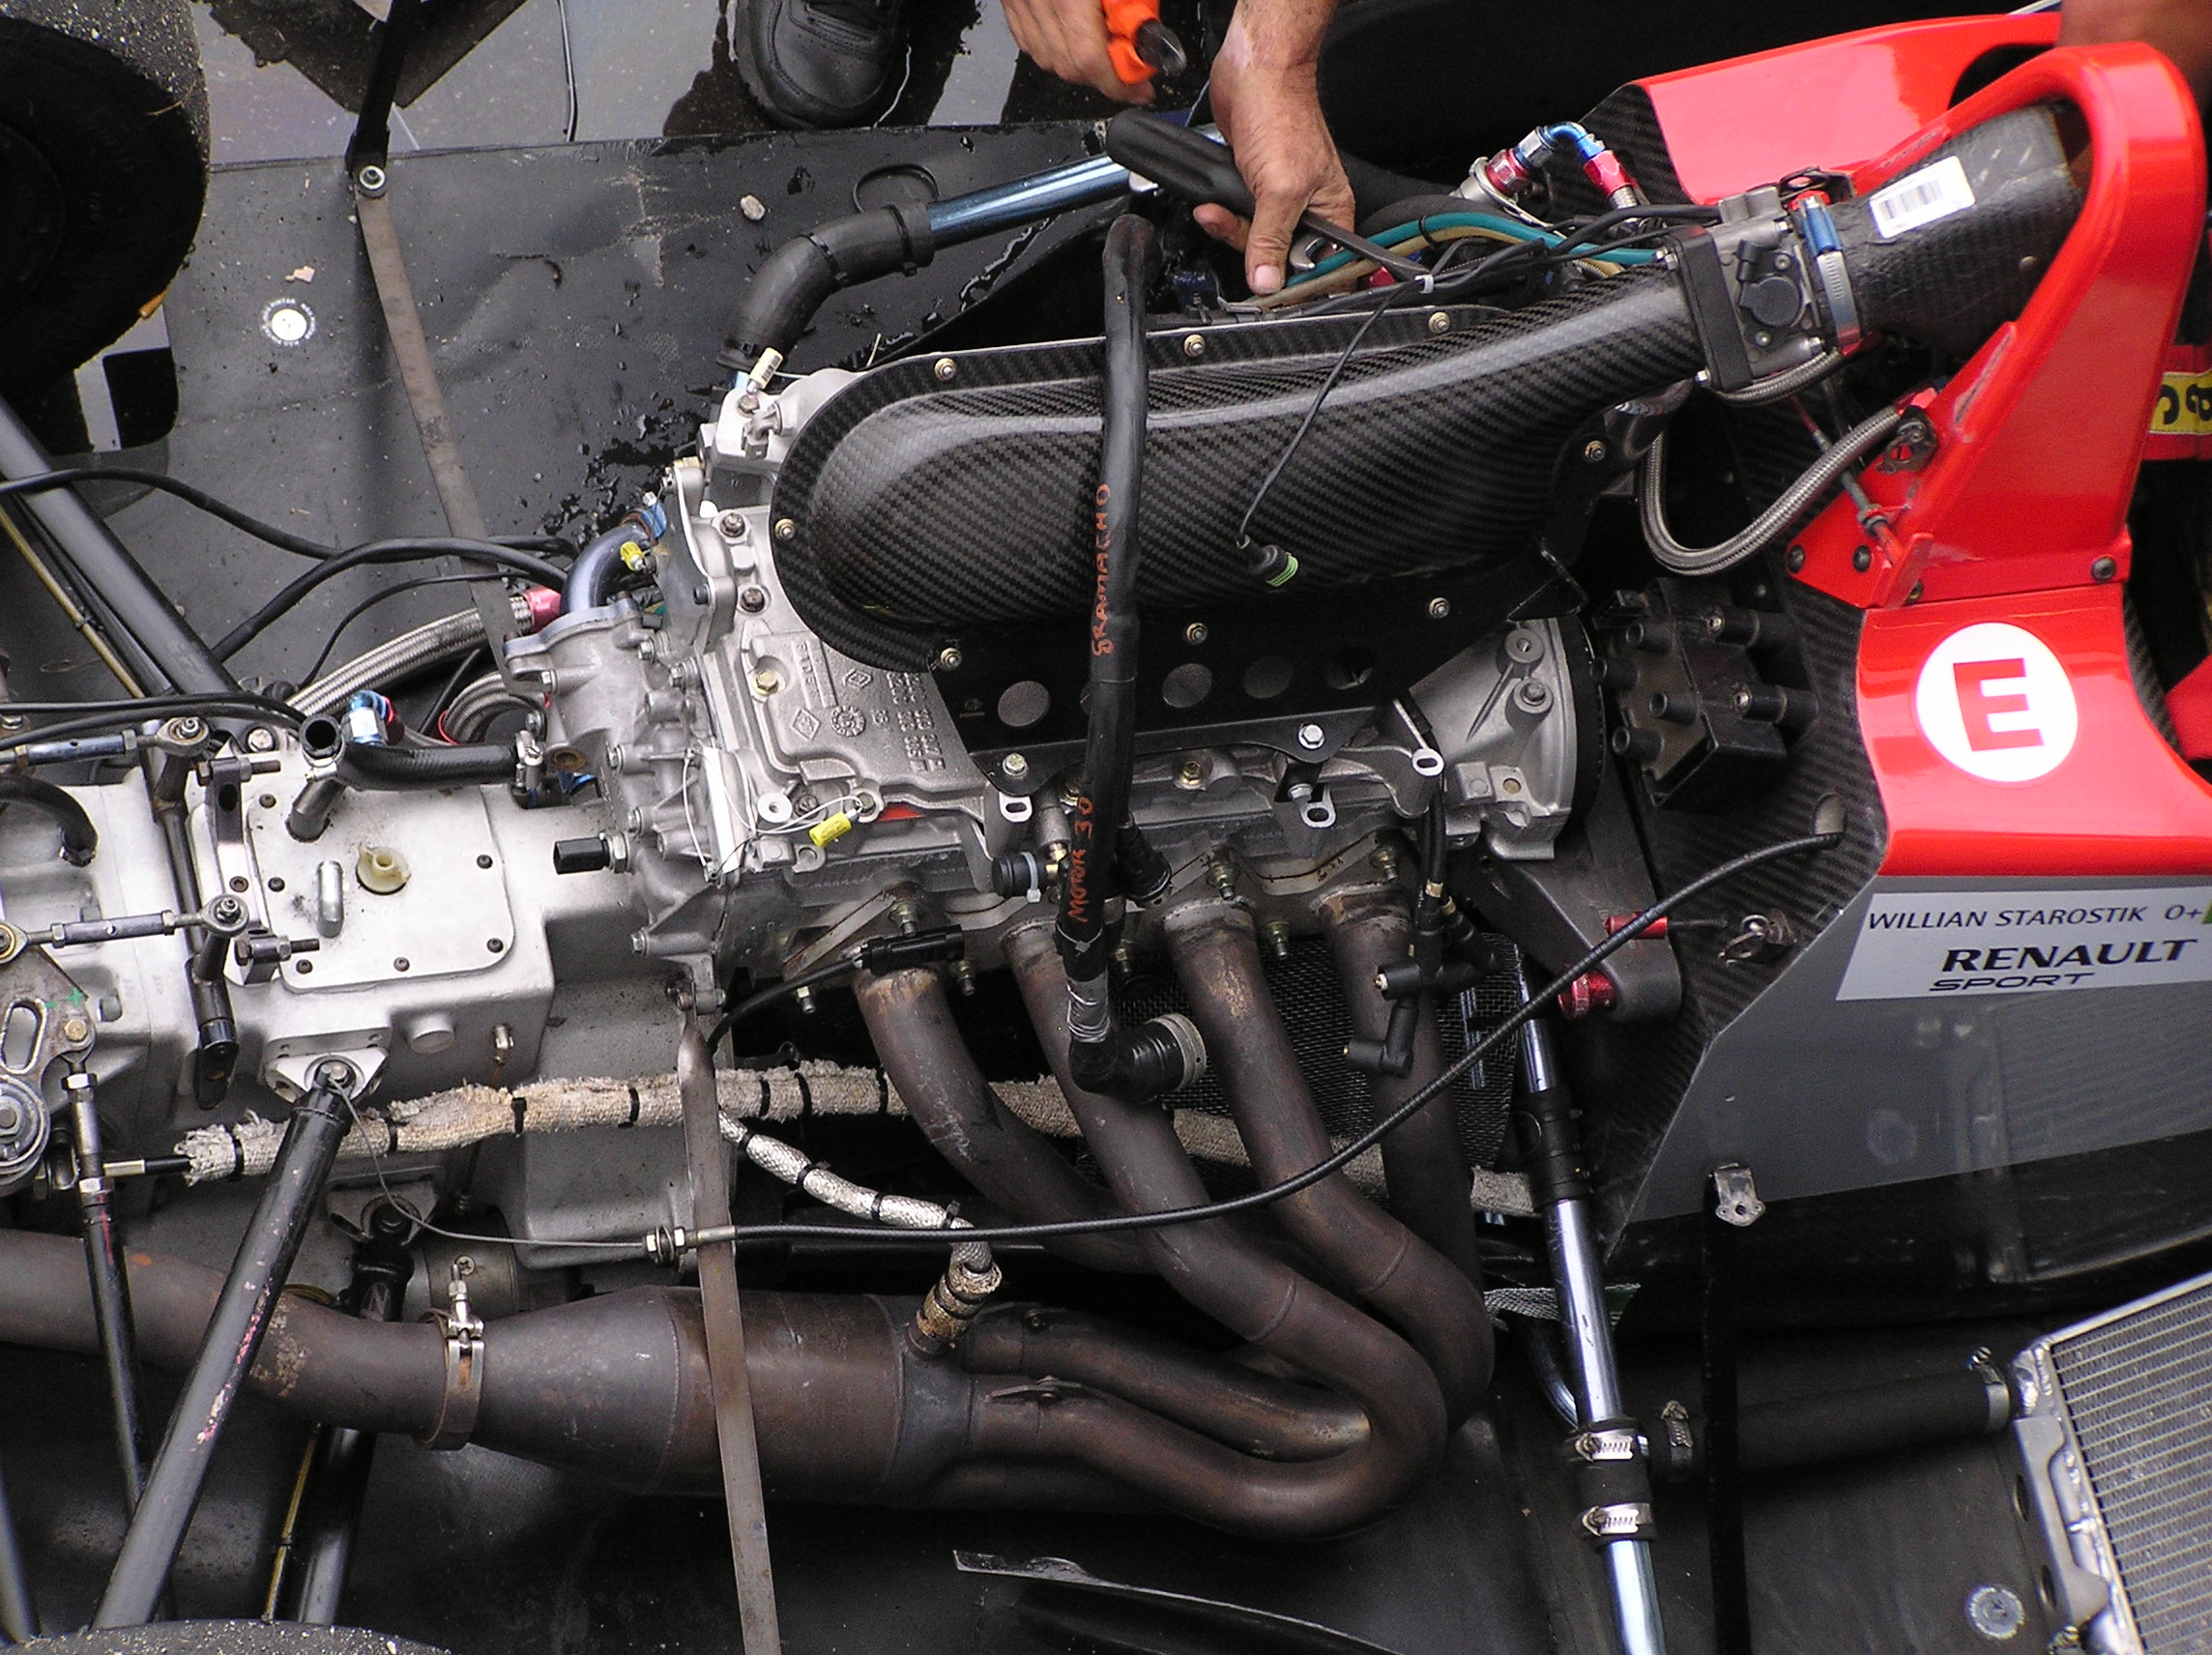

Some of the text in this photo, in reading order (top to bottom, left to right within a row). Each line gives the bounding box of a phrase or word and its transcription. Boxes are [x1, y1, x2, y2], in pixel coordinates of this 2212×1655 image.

[1953, 657, 2045, 752] E
[1067, 849, 1090, 923] MOTOR
[1869, 911, 1988, 930] WILLIAN
[1994, 906, 2148, 928] STAROSTIK
[1941, 939, 2198, 973] RENAULT
[1929, 973, 2096, 993] SPORT
